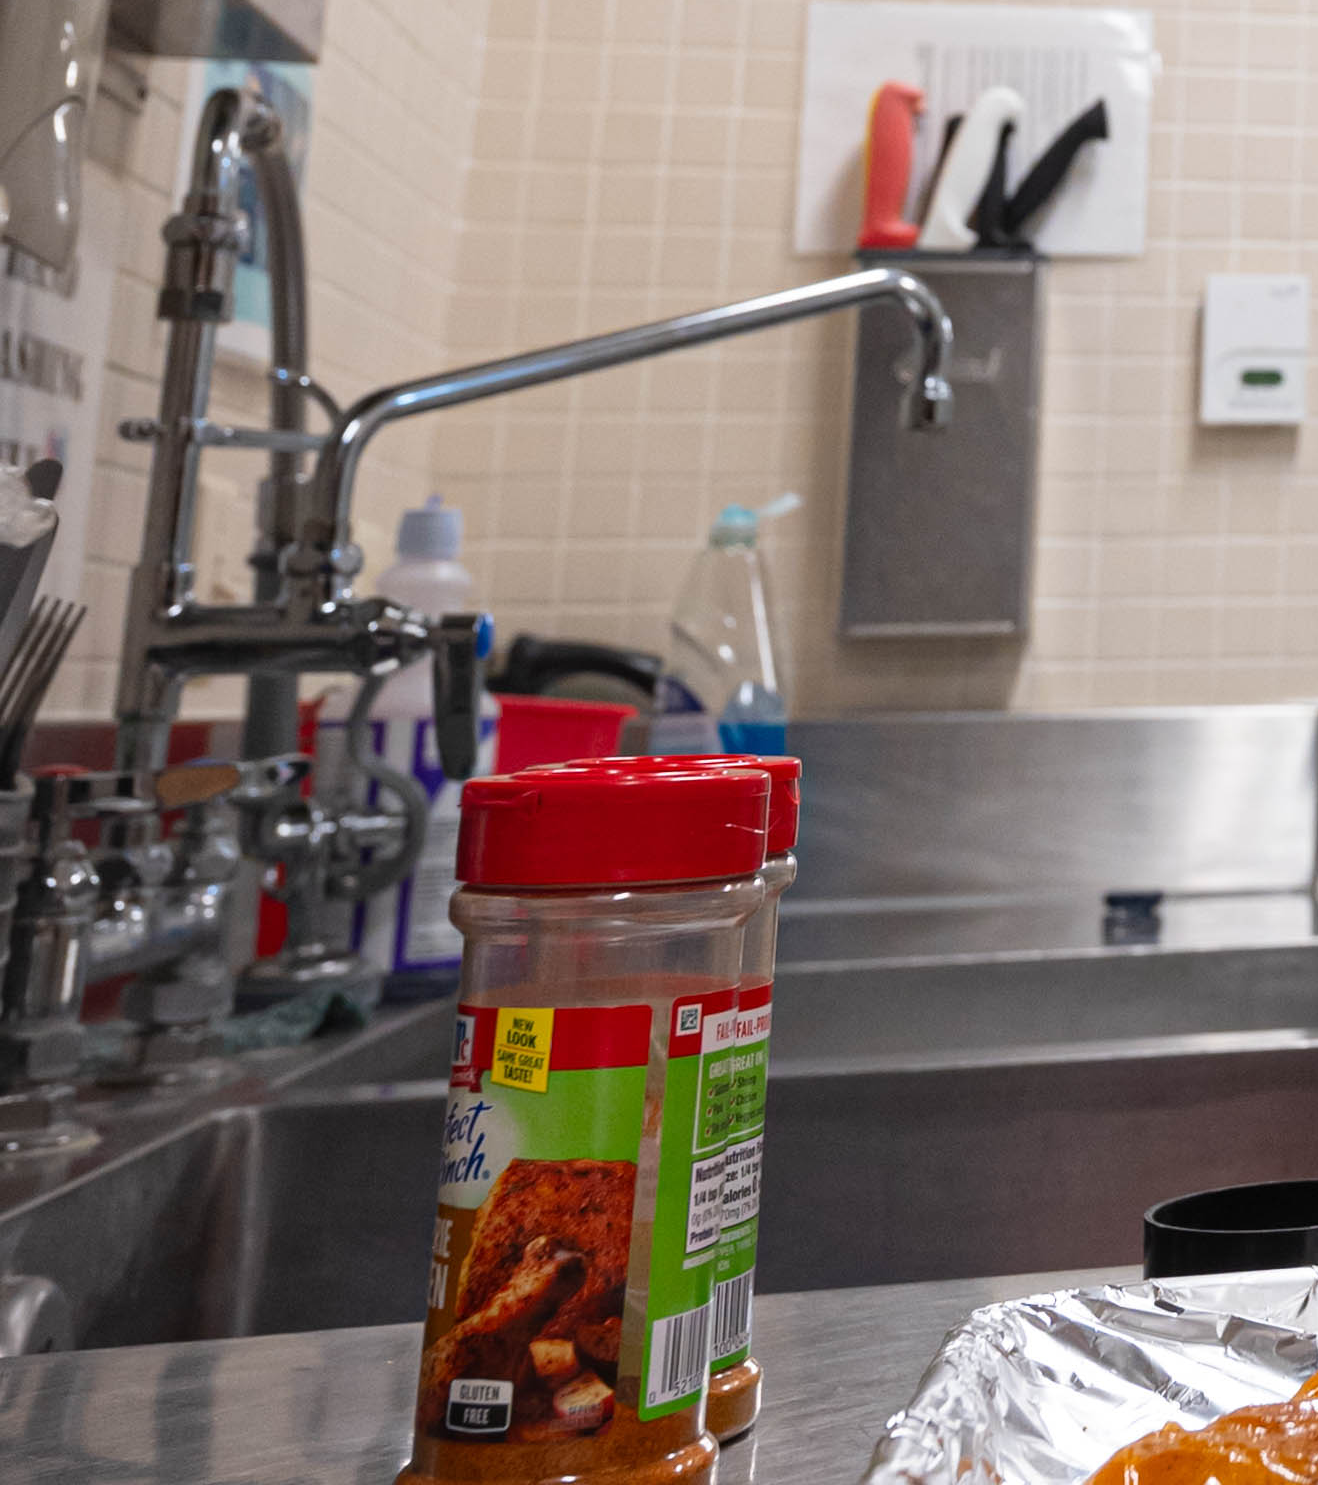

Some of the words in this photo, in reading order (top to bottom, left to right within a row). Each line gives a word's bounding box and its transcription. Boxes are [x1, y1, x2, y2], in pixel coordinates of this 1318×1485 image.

[512, 1017, 535, 1032] NEW
[506, 1029, 538, 1049] LOOK
[497, 1049, 517, 1063] SAME
[518, 1053, 545, 1070] GREAT
[503, 1065, 534, 1084] TASTE!
[445, 1100, 494, 1145] fect
[725, 1146, 756, 1166] utrition
[722, 1185, 751, 1205] alories
[459, 1383, 501, 1401] GLUTEN
[463, 1407, 490, 1425] FREE
